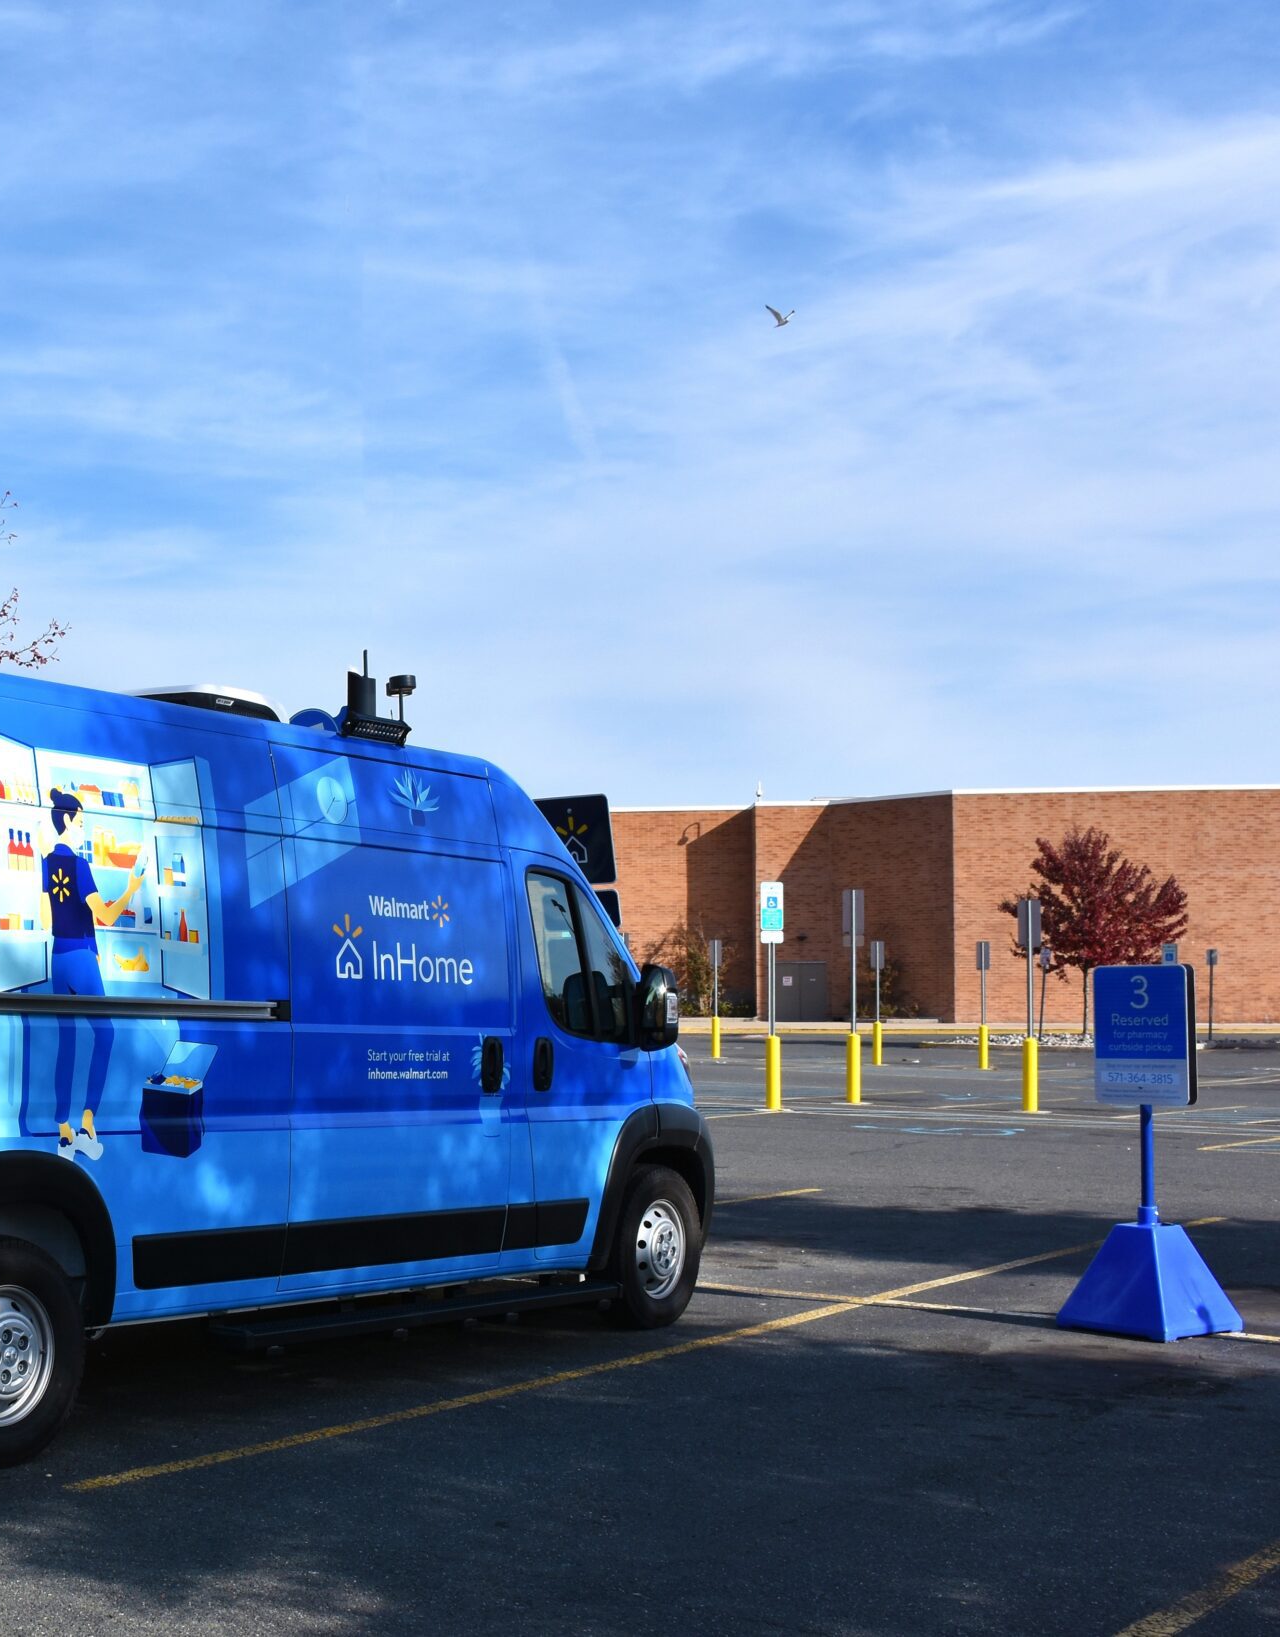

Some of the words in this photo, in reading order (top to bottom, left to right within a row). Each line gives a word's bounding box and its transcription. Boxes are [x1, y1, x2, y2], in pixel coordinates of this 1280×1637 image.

[369, 895, 430, 921] Walmart
[372, 940, 474, 985] InHome
[1130, 975, 1149, 1009] 3
[1111, 1013, 1169, 1026] Reserved
[1113, 1029, 1126, 1039] for
[1127, 1030, 1168, 1041] pharmacy
[1108, 1042, 1144, 1051] curbside
[1145, 1042, 1173, 1053] pickup
[367, 1049, 387, 1062] Start
[388, 1052, 407, 1064] your
[408, 1049, 424, 1062] free
[426, 1049, 441, 1062] trial
[441, 1051, 450, 1062] at
[368, 1067, 448, 1080] inhome.walmart.com
[1108, 1072, 1174, 1085] 571-364-3815
